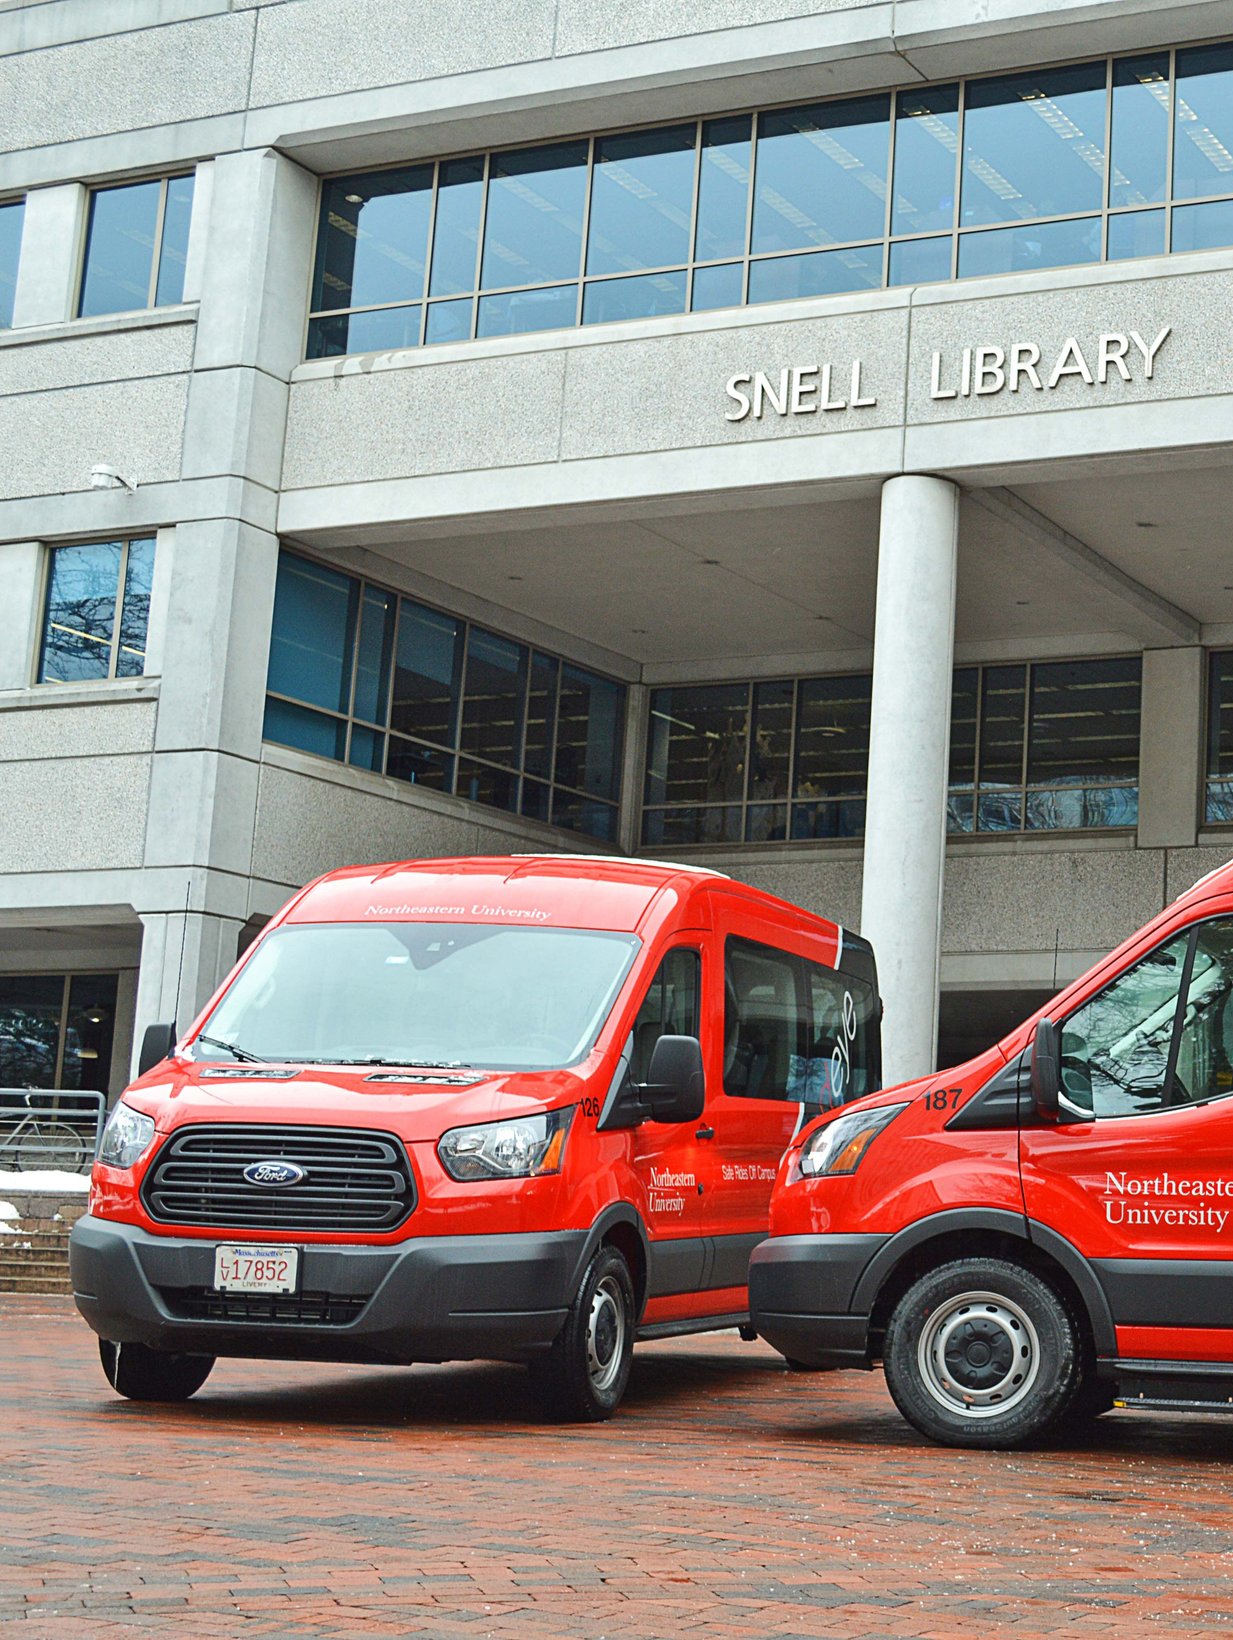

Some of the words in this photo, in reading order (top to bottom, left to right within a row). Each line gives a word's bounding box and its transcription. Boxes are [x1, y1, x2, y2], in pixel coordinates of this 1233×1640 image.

[724, 359, 877, 422] SNELL
[929, 326, 1172, 401] LIBRARY
[363, 904, 465, 916] Northeastern
[471, 904, 551, 921] University
[580, 1097, 600, 1117] 126
[922, 1088, 963, 1111] 187
[254, 1165, 288, 1181] Ford
[650, 1167, 696, 1187] Northeastern
[721, 1164, 735, 1181] Safe
[757, 1164, 776, 1182] Campus
[649, 1191, 686, 1217] University
[1104, 1201, 1230, 1233] University
[231, 1259, 288, 1281] 17852
